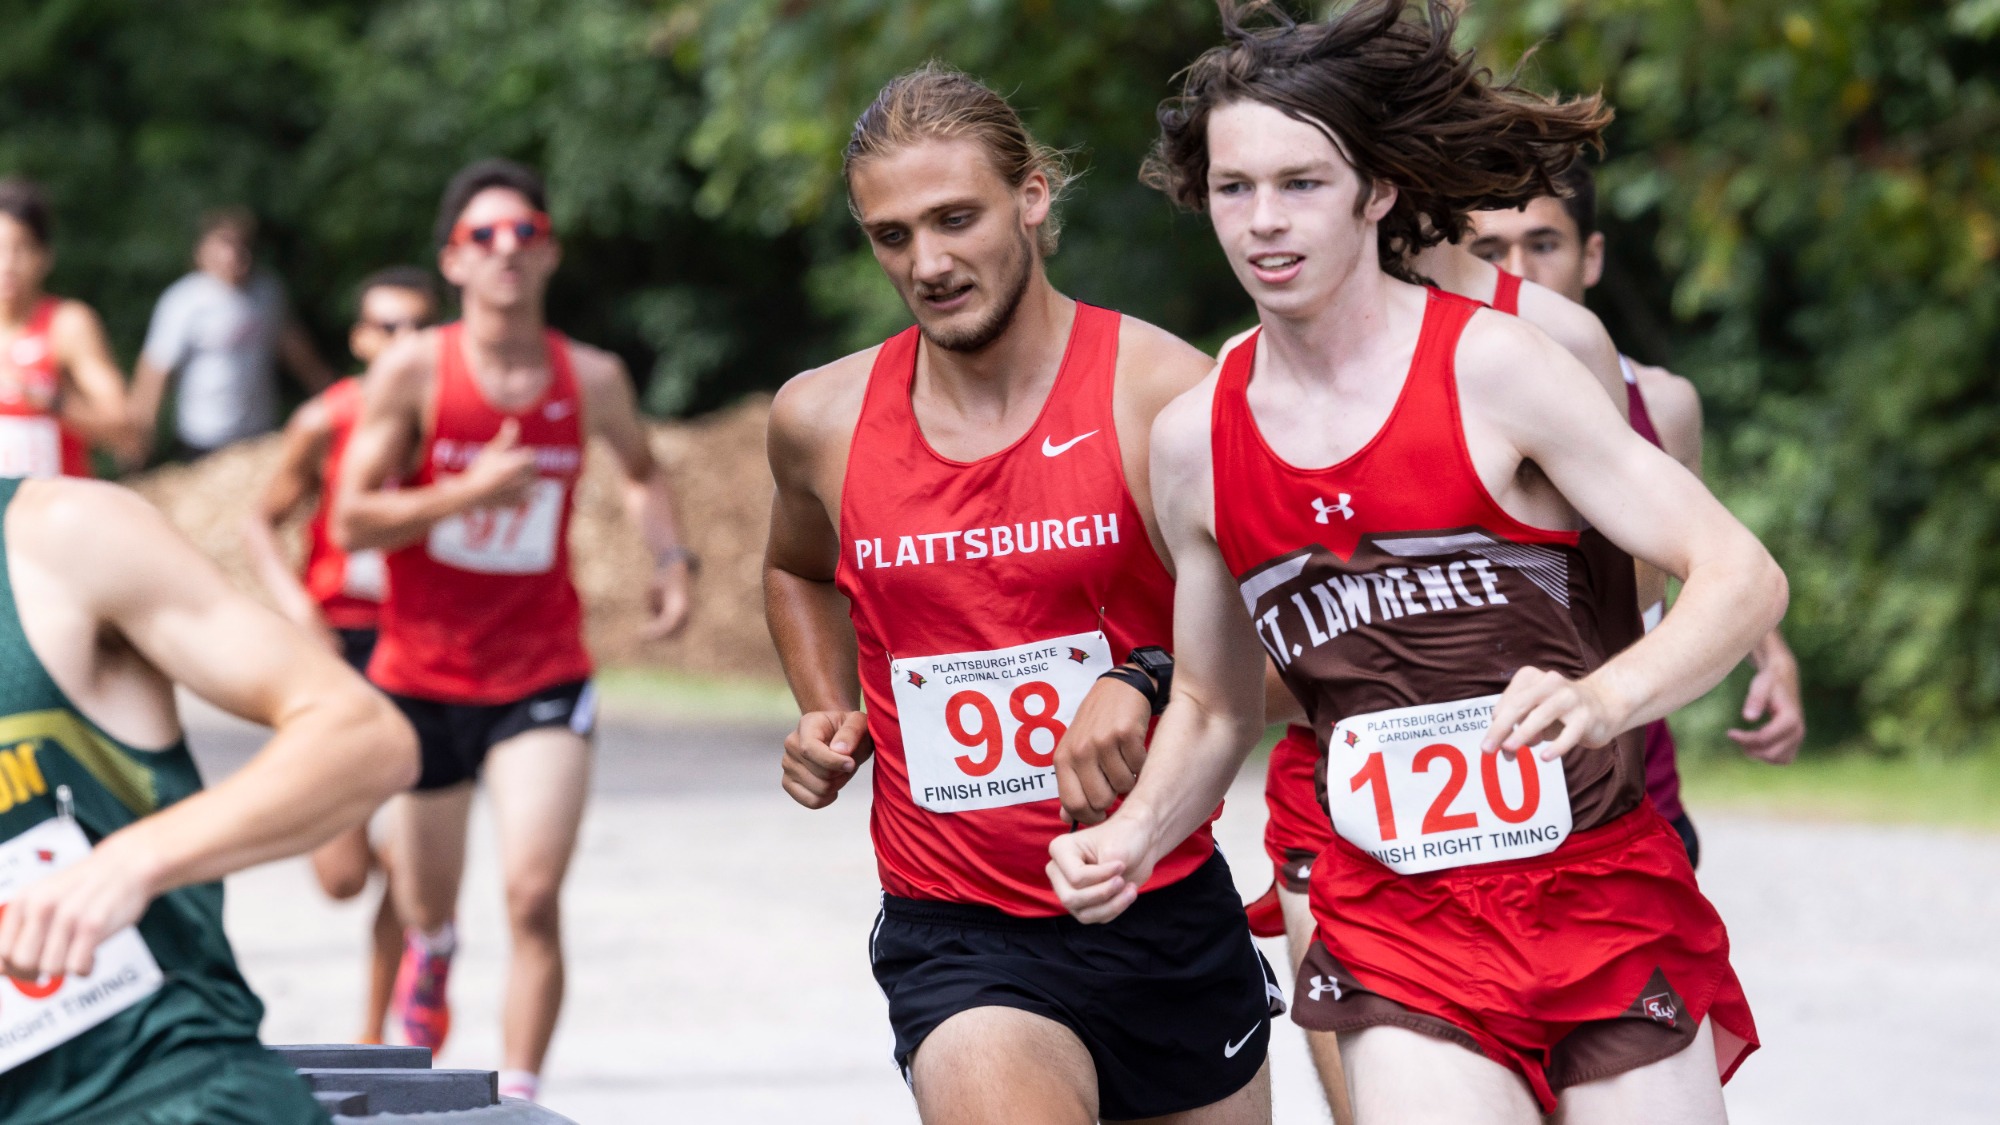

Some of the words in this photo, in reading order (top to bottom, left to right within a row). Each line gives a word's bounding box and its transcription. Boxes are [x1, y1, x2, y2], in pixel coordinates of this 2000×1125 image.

[854, 513, 1120, 570] PLATTSBURGH
[1291, 558, 1510, 648] LAWRENCE
[932, 655, 1016, 674] PLATTSBURGH
[1018, 646, 1058, 666] STATE
[945, 671, 1000, 686] CARDINAL
[1001, 662, 1050, 680] CLASSIC
[945, 680, 1068, 777] 98
[1366, 711, 1455, 733] PLATTSBURGH
[1378, 728, 1437, 744] CARDINAL
[1438, 720, 1489, 736] CLASSIC
[924, 782, 983, 803] FINISH
[986, 773, 1046, 798] RIGHT
[1350, 743, 1541, 842] 120
[1423, 834, 1482, 859] RIGHT
[1493, 825, 1560, 849] TIMING
